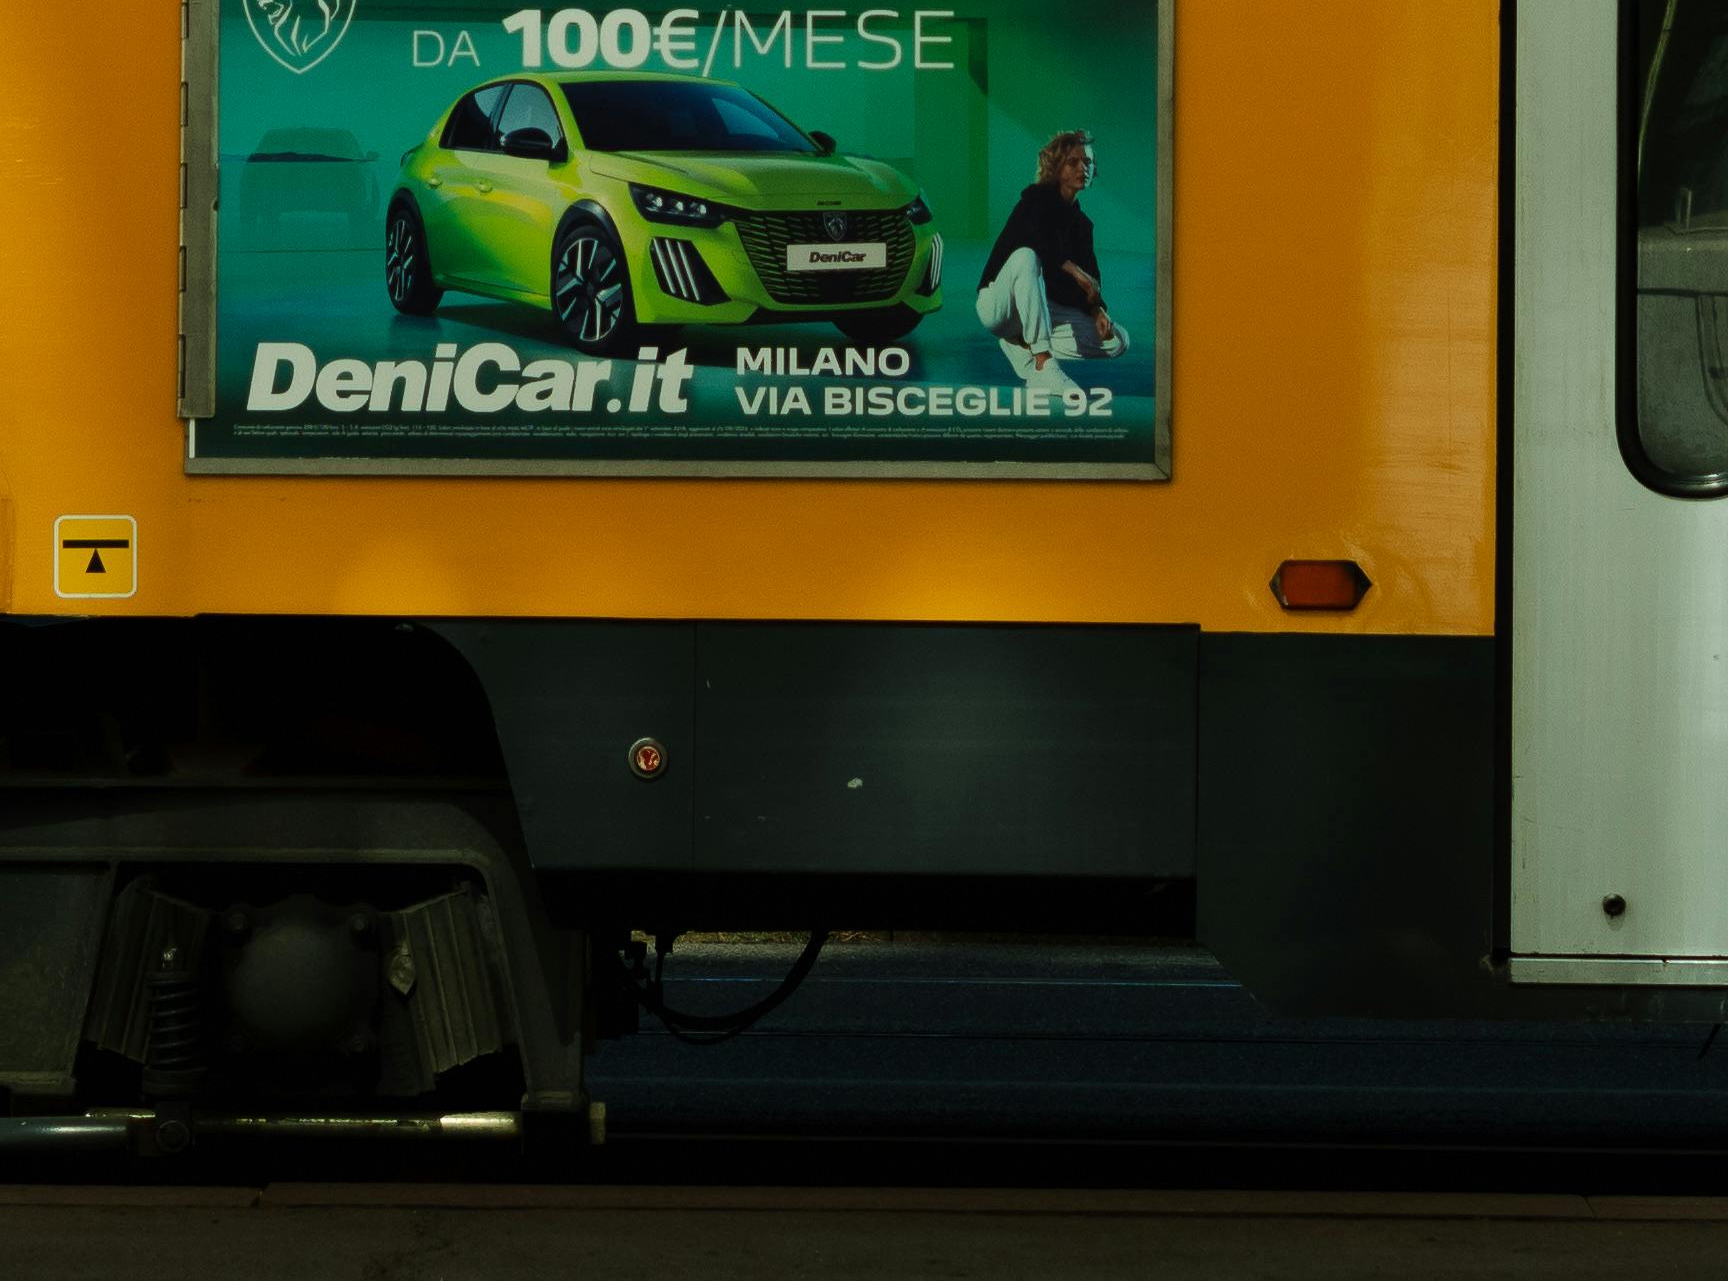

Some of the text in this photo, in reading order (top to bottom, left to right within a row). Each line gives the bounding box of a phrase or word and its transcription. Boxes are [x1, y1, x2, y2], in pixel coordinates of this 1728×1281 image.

[412, 30, 480, 67] DA
[809, 250, 867, 263] DeniCar
[736, 347, 910, 376] MILANO
[246, 342, 694, 412] DeniCar.it
[735, 387, 1113, 417] VIA BISCEGLIE 92
